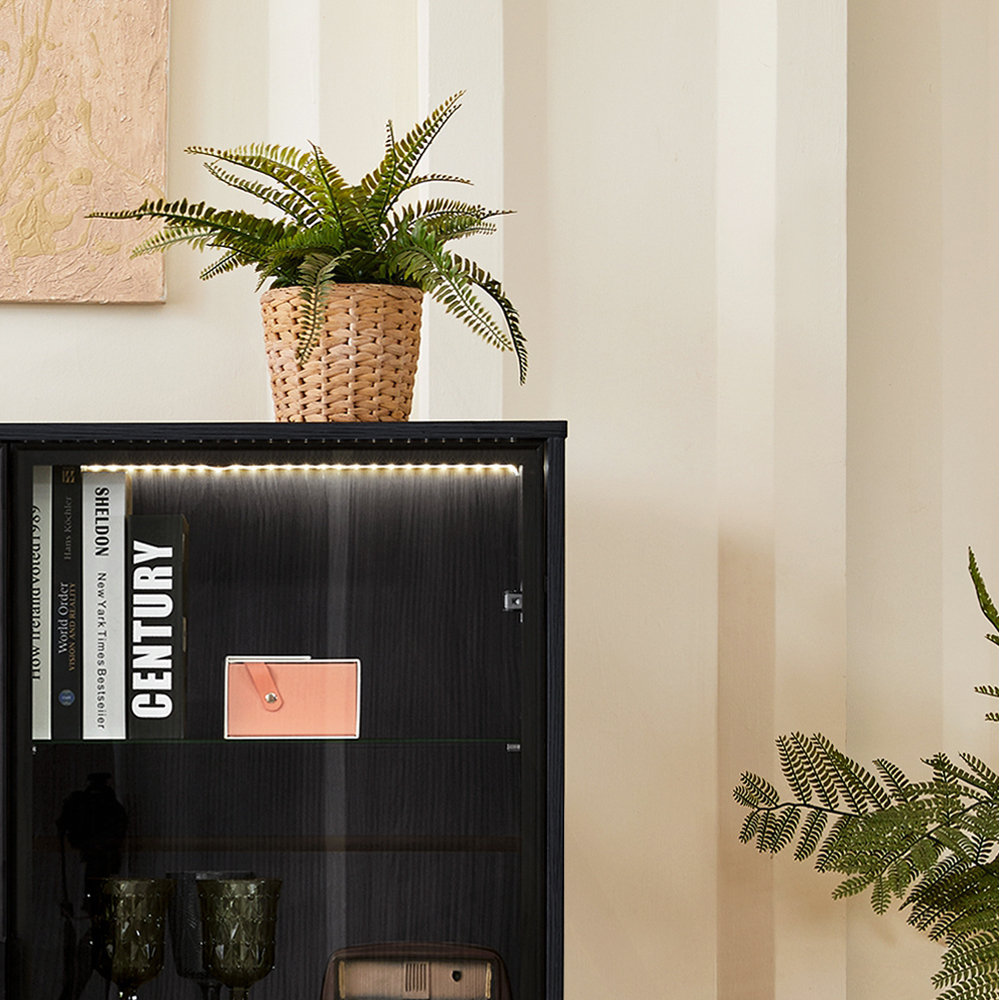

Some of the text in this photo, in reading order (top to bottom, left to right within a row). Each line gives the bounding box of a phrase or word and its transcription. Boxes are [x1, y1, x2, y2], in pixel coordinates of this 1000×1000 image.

[63, 535, 73, 560] Hans
[94, 487, 110, 557] SHELDON
[57, 582, 69, 654] World Order
[97, 572, 107, 598] New
[68, 582, 76, 672] VISION AND REALITY
[97, 630, 107, 666] Times
[131, 540, 173, 718] CENTURY
